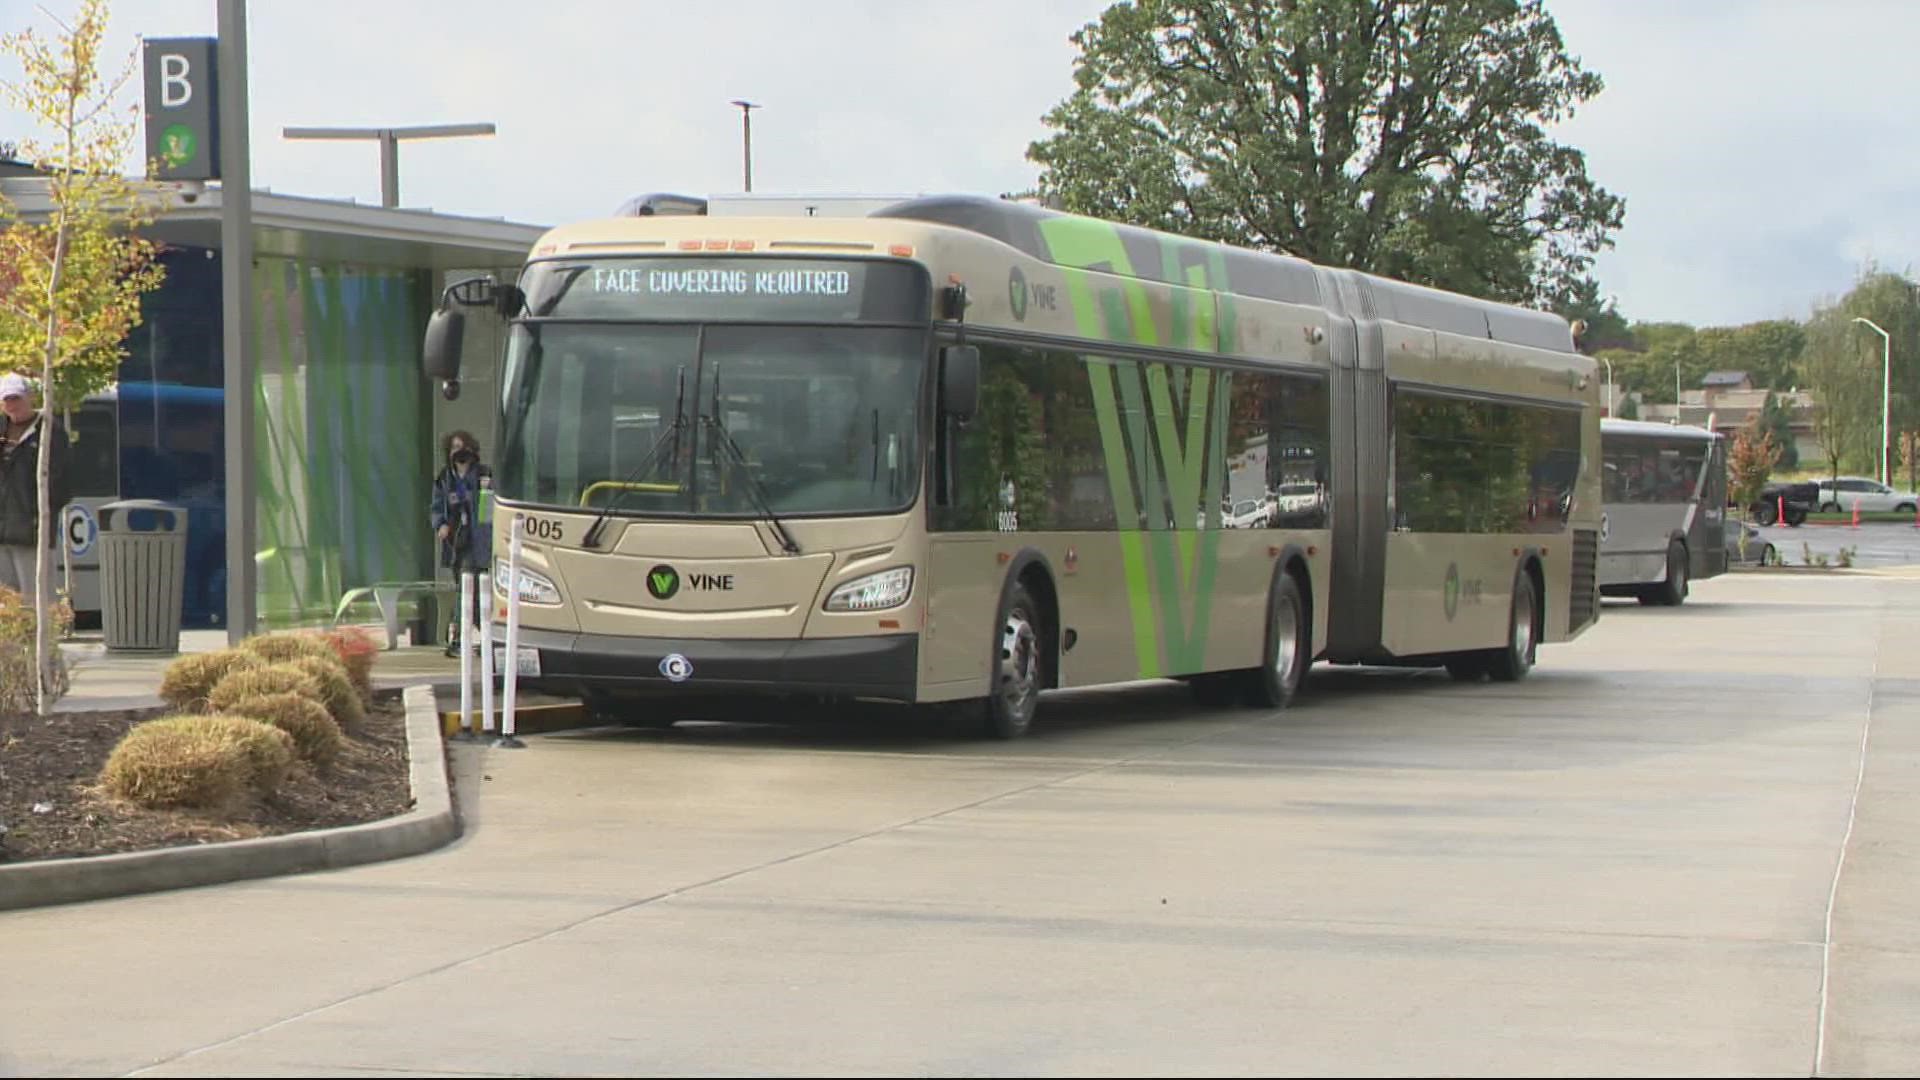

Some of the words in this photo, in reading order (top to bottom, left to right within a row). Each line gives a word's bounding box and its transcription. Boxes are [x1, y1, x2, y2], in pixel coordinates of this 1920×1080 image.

[161, 53, 192, 107] B
[594, 269, 641, 293] FACE
[1031, 282, 1056, 312] VINE
[69, 515, 84, 545] C
[688, 573, 735, 591] VINE
[669, 660, 681, 676] C
